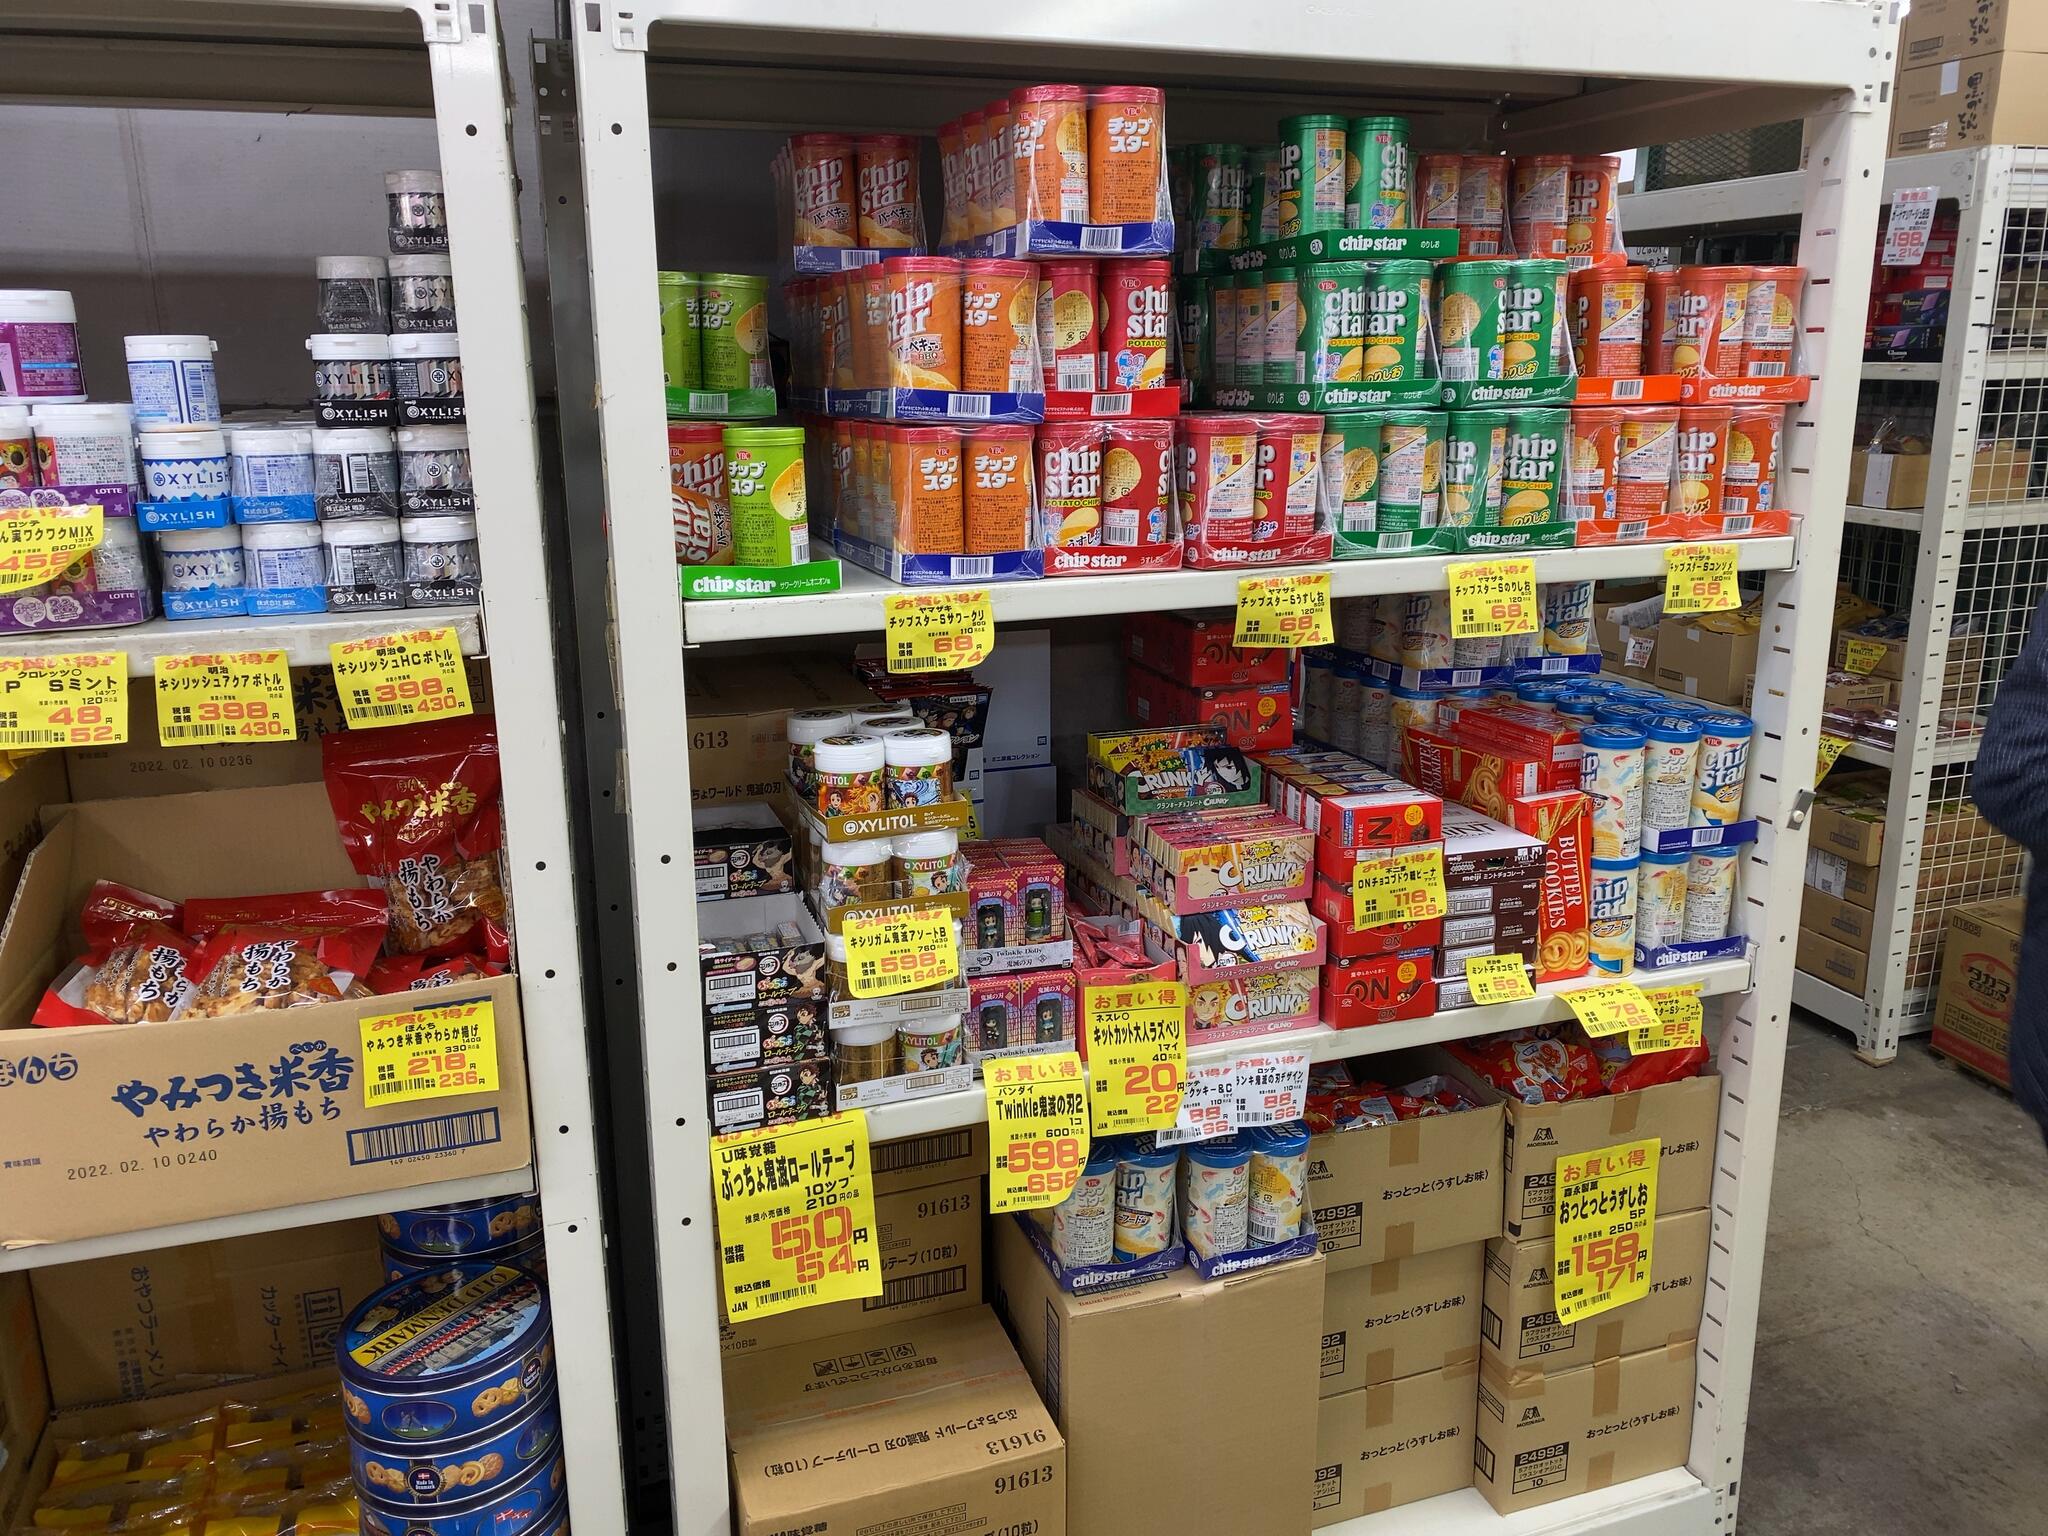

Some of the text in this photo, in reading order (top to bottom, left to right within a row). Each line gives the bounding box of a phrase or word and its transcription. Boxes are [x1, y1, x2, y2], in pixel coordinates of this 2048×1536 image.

[1108, 117, 1153, 136] チップ
[1109, 135, 1150, 154] スター
[860, 158, 910, 192] chip
[1339, 235, 1373, 252] chip
[1374, 235, 1407, 251] star
[964, 291, 1001, 309] チップ
[1128, 284, 1168, 314] chi
[964, 310, 998, 326] スター
[1127, 312, 1167, 338] sta
[324, 374, 386, 385] XYLISH
[1325, 390, 1391, 404] chip star
[1472, 386, 1532, 401] chip star
[1708, 383, 1765, 397] chip star
[336, 409, 388, 418] XYLISH
[729, 461, 767, 479] チップ
[920, 457, 958, 472] チップ
[974, 456, 1018, 472] チップ
[976, 473, 1016, 490] スター
[422, 498, 470, 507] XYLISH
[160, 511, 215, 521] XYLISH
[1468, 532, 1531, 547] chip star
[1055, 552, 1127, 570] chip star
[1213, 549, 1281, 563] chip star
[423, 588, 474, 597] XYLISH
[693, 575, 776, 594] chip star
[1693, 582, 1721, 597] 68
[109, 592, 135, 600] LOTTE
[185, 599, 239, 610] XYLISH
[345, 592, 397, 602] XYLISH
[1702, 597, 1729, 609] 74
[1492, 604, 1522, 619] 68
[1280, 616, 1313, 632] 68
[1504, 619, 1529, 633] 74
[934, 635, 973, 653] 68
[1293, 631, 1321, 645] 74
[949, 651, 982, 667] 74
[375, 678, 443, 702] 398
[198, 702, 268, 720] 398
[417, 695, 457, 712] 430
[48, 706, 101, 725] 48
[240, 721, 281, 736] 430
[1704, 737, 1721, 746] YBC
[200, 757, 214, 768] 10
[220, 754, 253, 768] 0236
[1702, 743, 1749, 770] chip
[1136, 769, 1212, 789] CRUNKY
[1701, 764, 1748, 790] star
[858, 813, 918, 834] XYLITOL
[912, 859, 947, 871] XYLITOL
[1559, 834, 1582, 908] BUTTER
[1218, 861, 1305, 889] CRUNKY
[400, 859, 431, 931] 揚もち
[421, 854, 453, 923] やわらか
[1546, 849, 1567, 929] COOKIES
[1394, 890, 1427, 907] 118
[1407, 904, 1437, 917] 128
[1220, 924, 1308, 951] CRUNKY
[242, 943, 269, 992] 揚もち
[881, 953, 936, 973] 598
[1656, 950, 1707, 967] chip star
[1345, 976, 1390, 1002] ON
[1493, 978, 1519, 991] 59
[1095, 989, 1177, 1010] お買い得
[1094, 1019, 1180, 1047] キットカット大人ラズベリ
[445, 1045, 466, 1053] 330
[1152, 1053, 1167, 1061] 40
[408, 1053, 466, 1076] 218
[995, 1061, 1077, 1083] お買い得
[111, 1048, 353, 1118] やみつき米香
[439, 1071, 478, 1088] 236
[1124, 1062, 1177, 1095] 20
[999, 1085, 1034, 1096] バンダイ
[1146, 1094, 1179, 1115] 22
[144, 1097, 341, 1148] やわらか揚もち
[1046, 1128, 1070, 1137] 600
[153, 1149, 217, 1169] 10 0240
[1008, 1138, 1079, 1173] 598
[1563, 1149, 1647, 1183] お買い得
[806, 1194, 838, 1210] 210
[917, 1194, 970, 1219] 91613
[1559, 1183, 1648, 1225] おっとっとうすしお
[1630, 1209, 1646, 1219] 5P
[771, 1206, 868, 1260] 50 円
[1609, 1222, 1633, 1235] 250
[1571, 1232, 1640, 1277] 158
[795, 1245, 869, 1284] 54 円
[1211, 1256, 1271, 1277] chip star
[1072, 1268, 1136, 1288] chip star
[1595, 1262, 1636, 1293] 171
[361, 1271, 509, 1361] OLD DENMARK
[732, 1301, 748, 1313] JAN
[1517, 1417, 1545, 1428] MORINAGA
[985, 1429, 1047, 1456] 91613
[1519, 1445, 1564, 1464] 24992
[994, 1465, 1054, 1495] 91613
